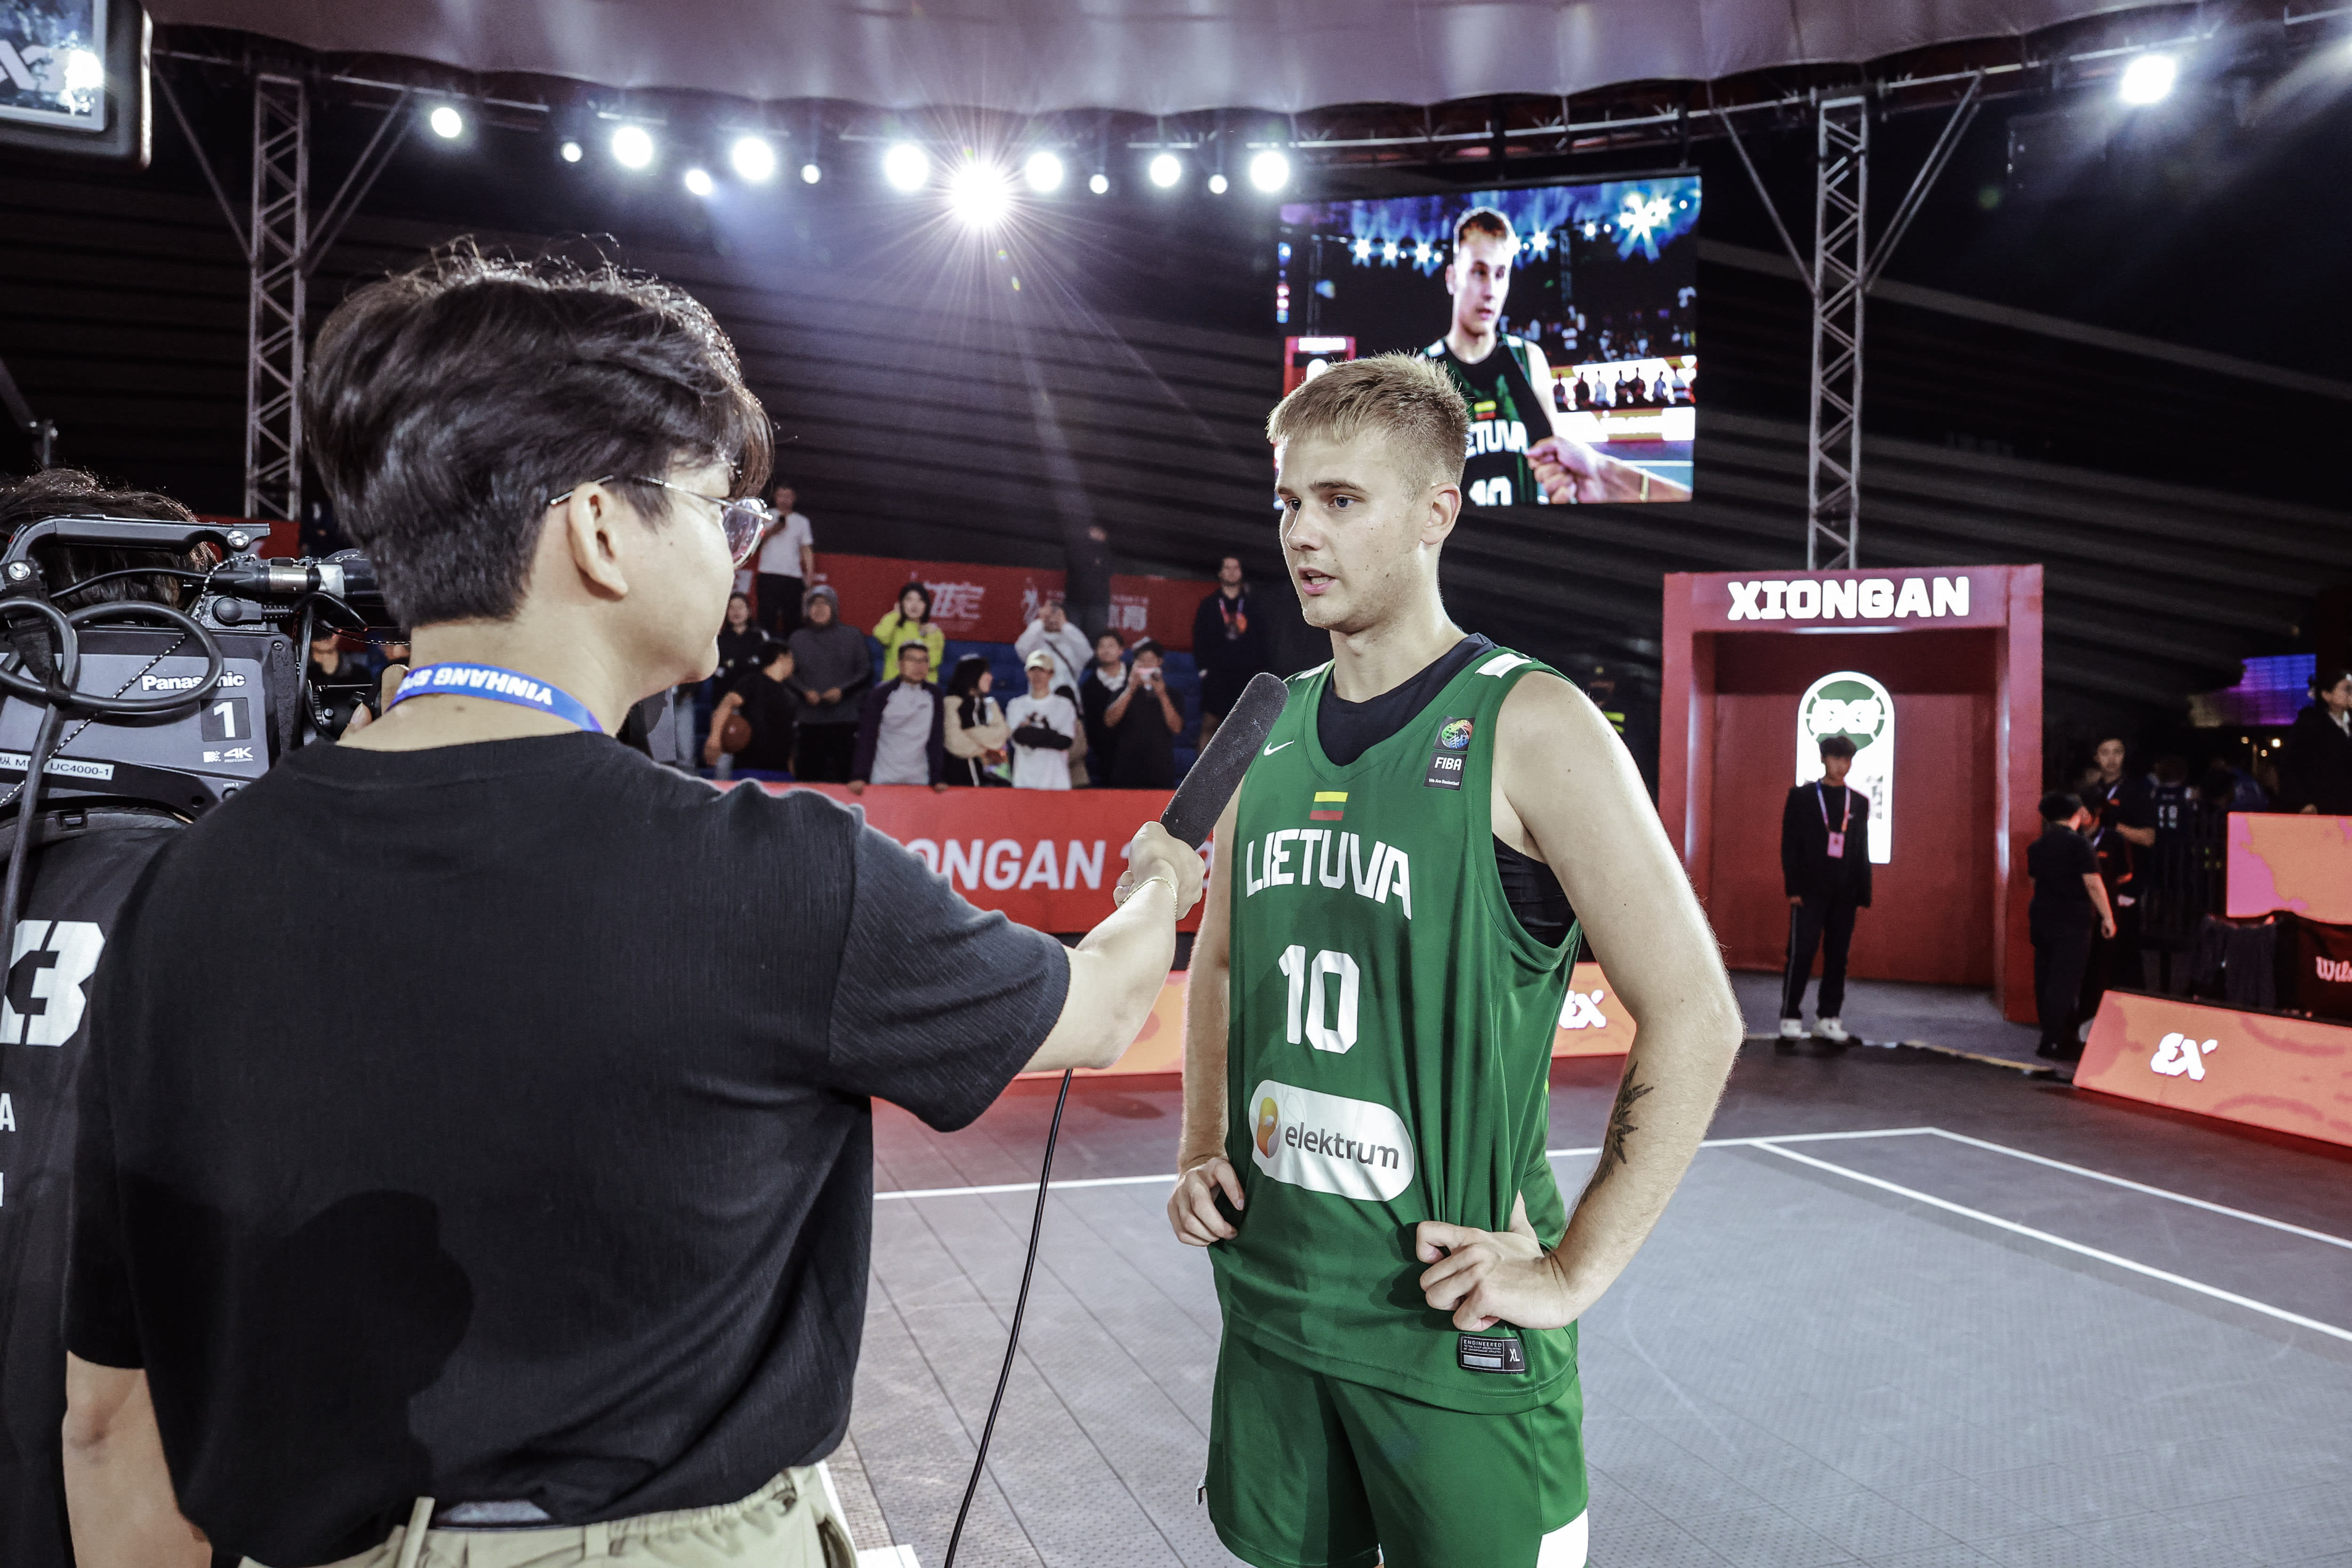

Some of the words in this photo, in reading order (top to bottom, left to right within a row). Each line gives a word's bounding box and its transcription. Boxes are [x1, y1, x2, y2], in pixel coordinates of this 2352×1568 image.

[1727, 576, 1969, 621] XIONGAN
[142, 671, 245, 691] Panasnic
[433, 667, 552, 706] YINHANG
[214, 701, 236, 738] 1
[50, 762, 109, 776] UC4000-1
[224, 747, 254, 758] 4K
[1434, 756, 1462, 771] FIBA
[1247, 829, 1411, 920] LIETUVA
[1278, 944, 1360, 1054] 10
[1285, 1122, 1399, 1169] elektrum
[1510, 1348, 1520, 1361] XL
